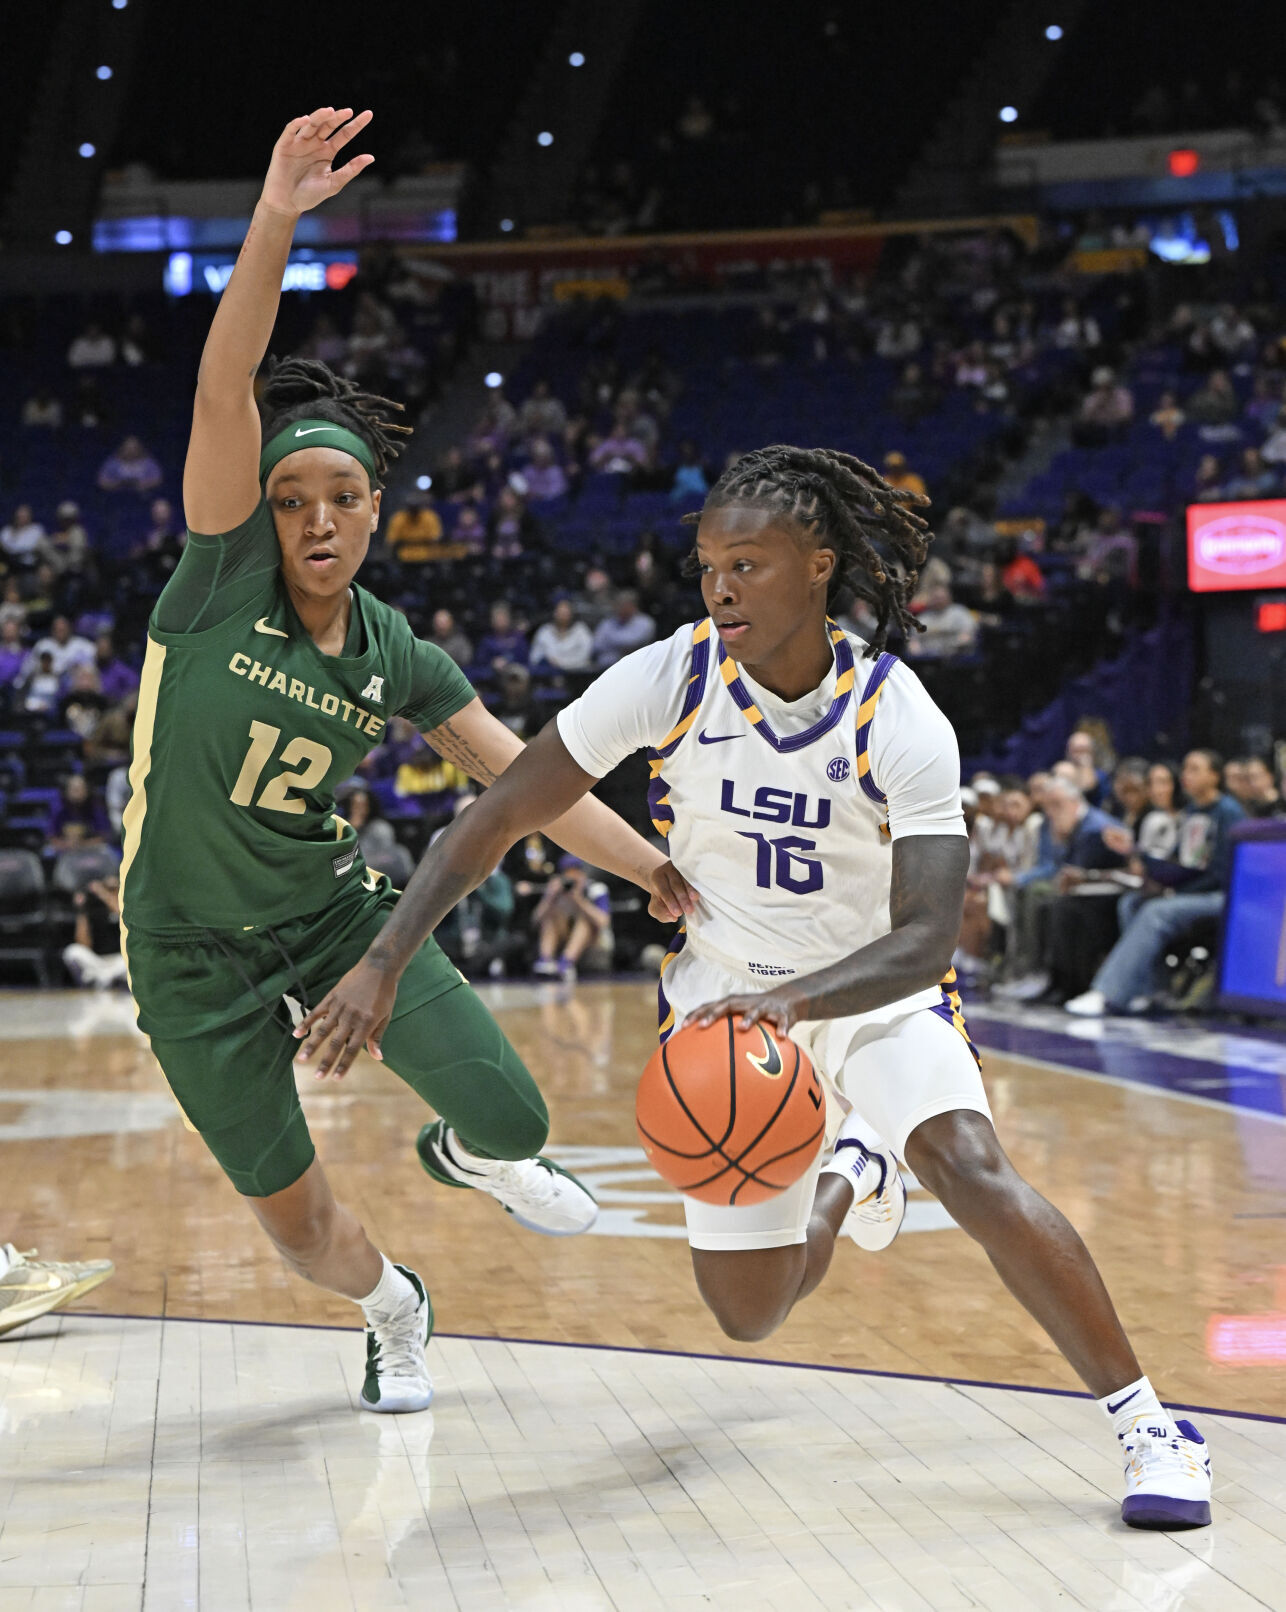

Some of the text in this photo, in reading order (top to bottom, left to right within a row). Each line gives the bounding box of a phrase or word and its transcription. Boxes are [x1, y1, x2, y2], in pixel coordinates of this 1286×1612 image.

[228, 652, 386, 736] CHARLOTTE
[361, 674, 384, 703] A
[230, 720, 332, 815] 12
[828, 759, 850, 780] SEC
[720, 778, 831, 829] LSU
[734, 830, 824, 895] 16
[748, 968, 796, 976] TIGERS
